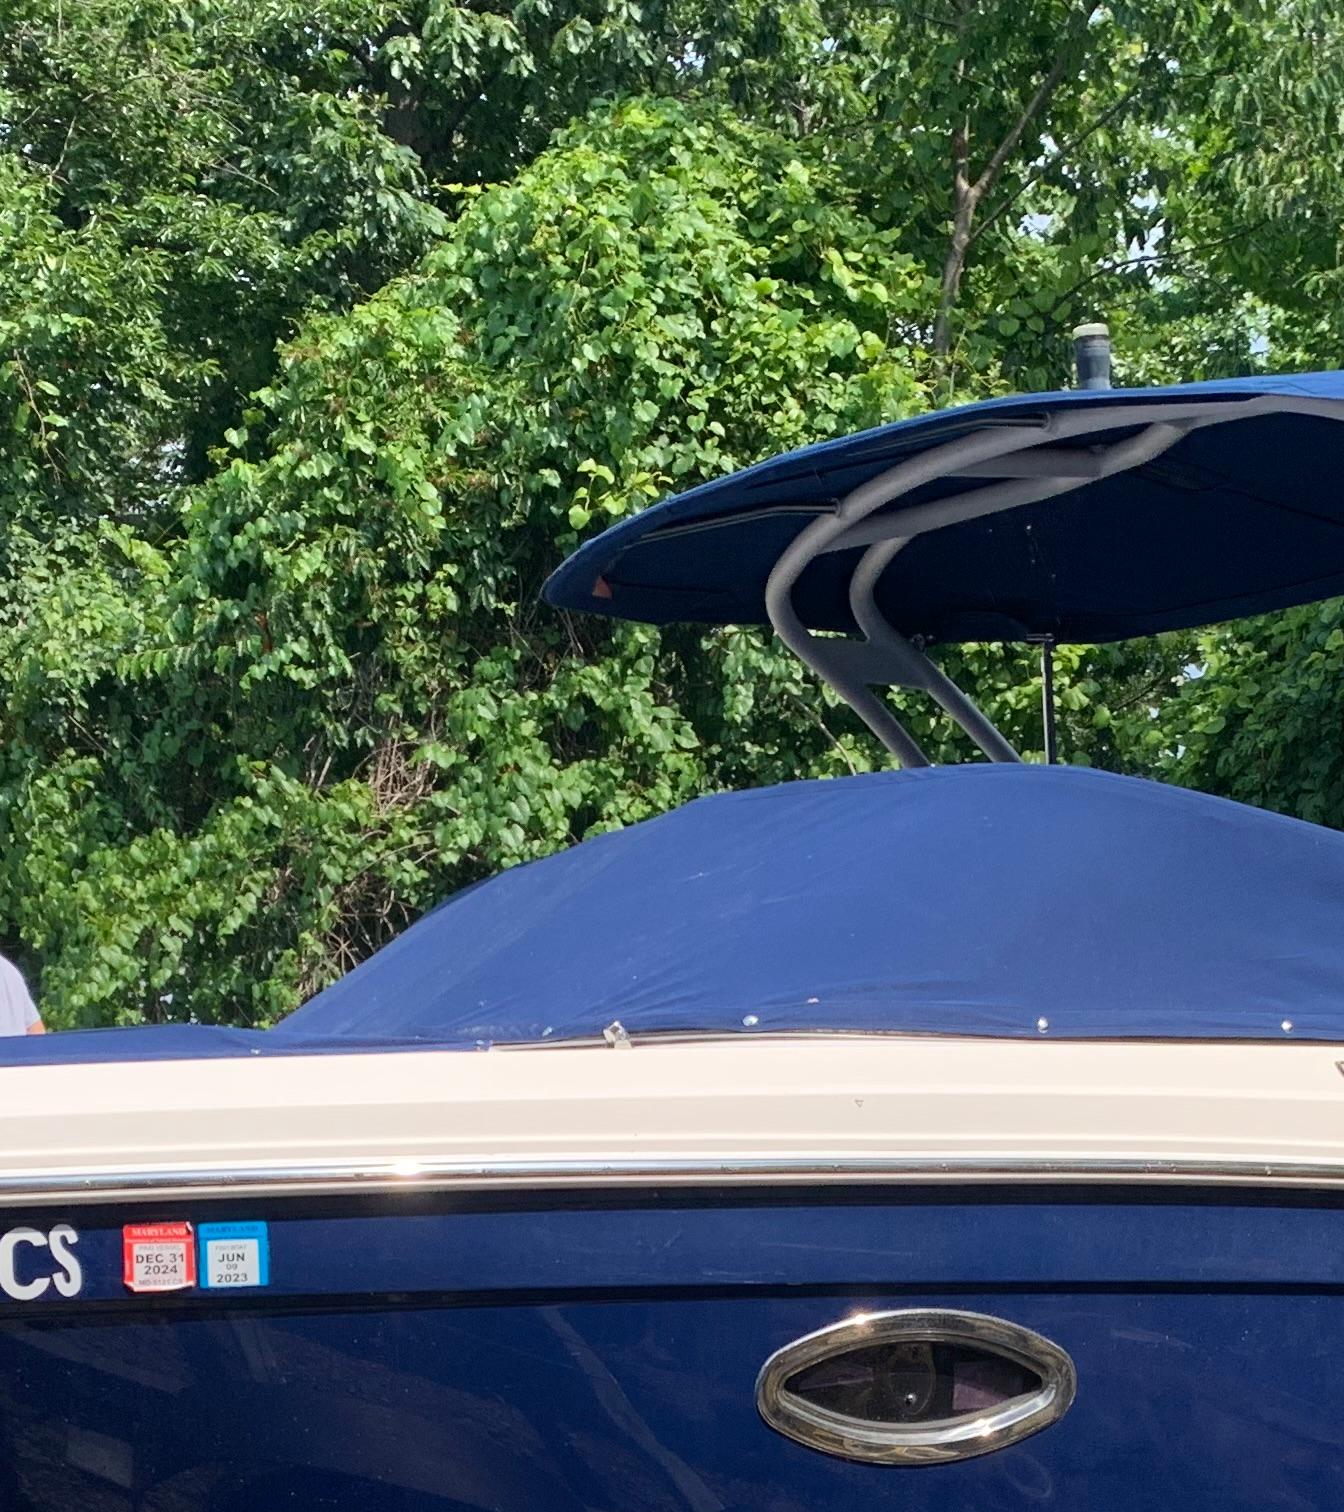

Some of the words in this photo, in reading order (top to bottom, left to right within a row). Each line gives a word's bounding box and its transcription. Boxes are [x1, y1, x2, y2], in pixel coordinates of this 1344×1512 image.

[132, 1227, 187, 1237] MARYLAND
[136, 1254, 164, 1264] DEC
[169, 1253, 185, 1263] 31
[218, 1253, 245, 1263] JUN
[144, 1265, 178, 1275] 2024
[217, 1274, 248, 1283] 2023
